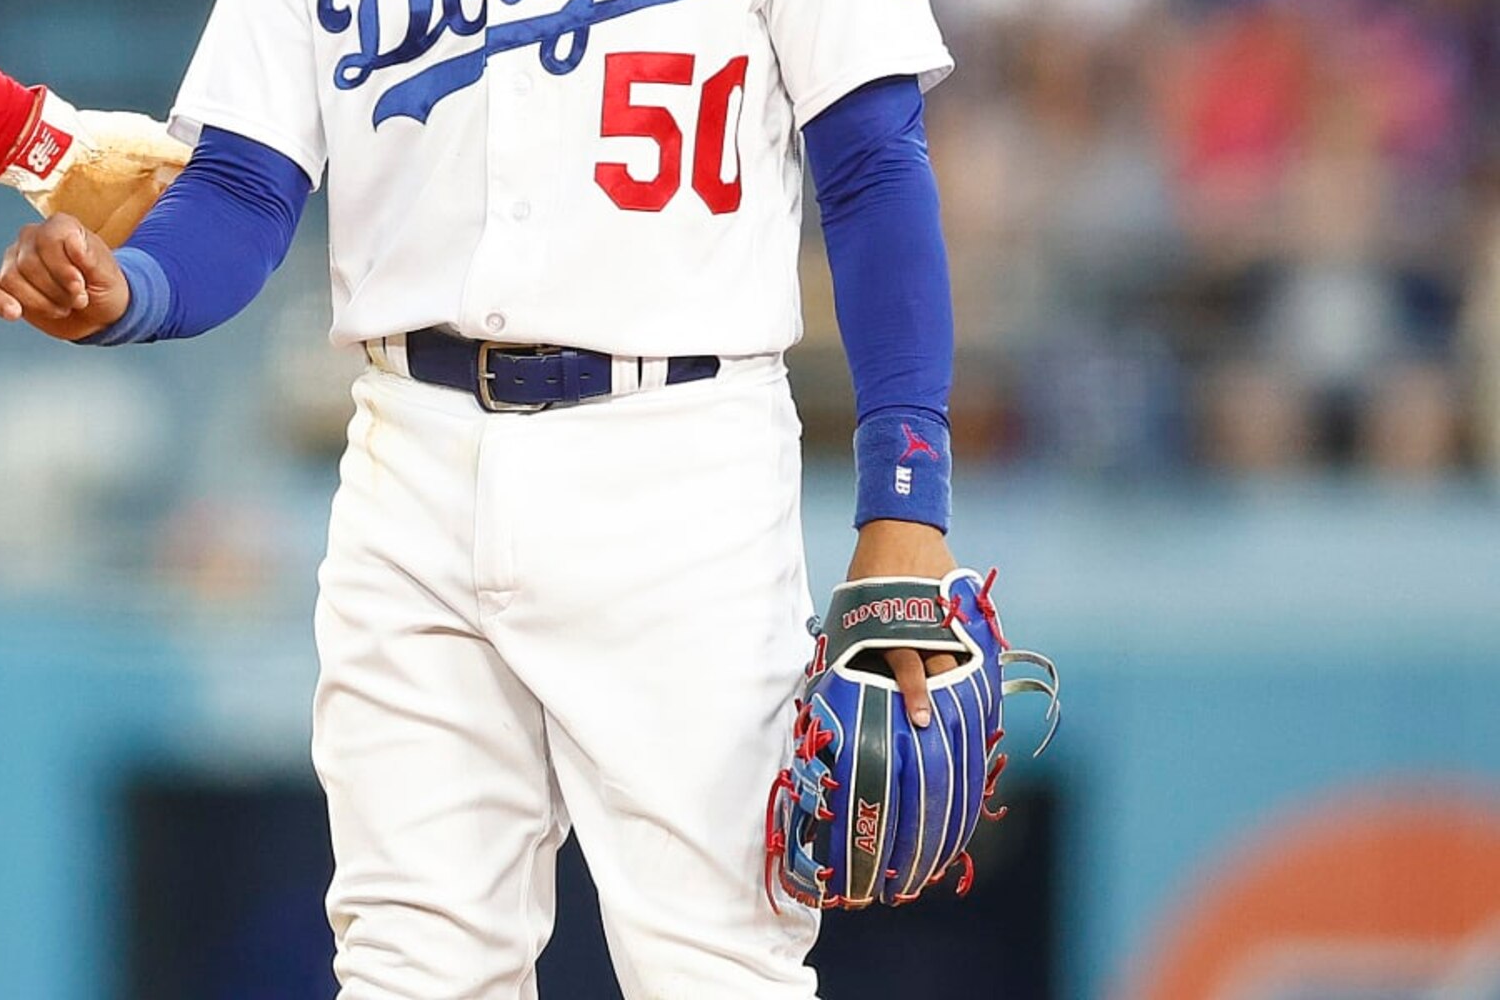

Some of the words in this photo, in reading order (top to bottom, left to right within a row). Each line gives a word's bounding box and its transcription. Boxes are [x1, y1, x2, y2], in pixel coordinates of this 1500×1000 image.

[594, 51, 749, 215] 50
[894, 464, 912, 496] MB
[842, 597, 938, 630] Wilson
[854, 797, 881, 856] A2K
